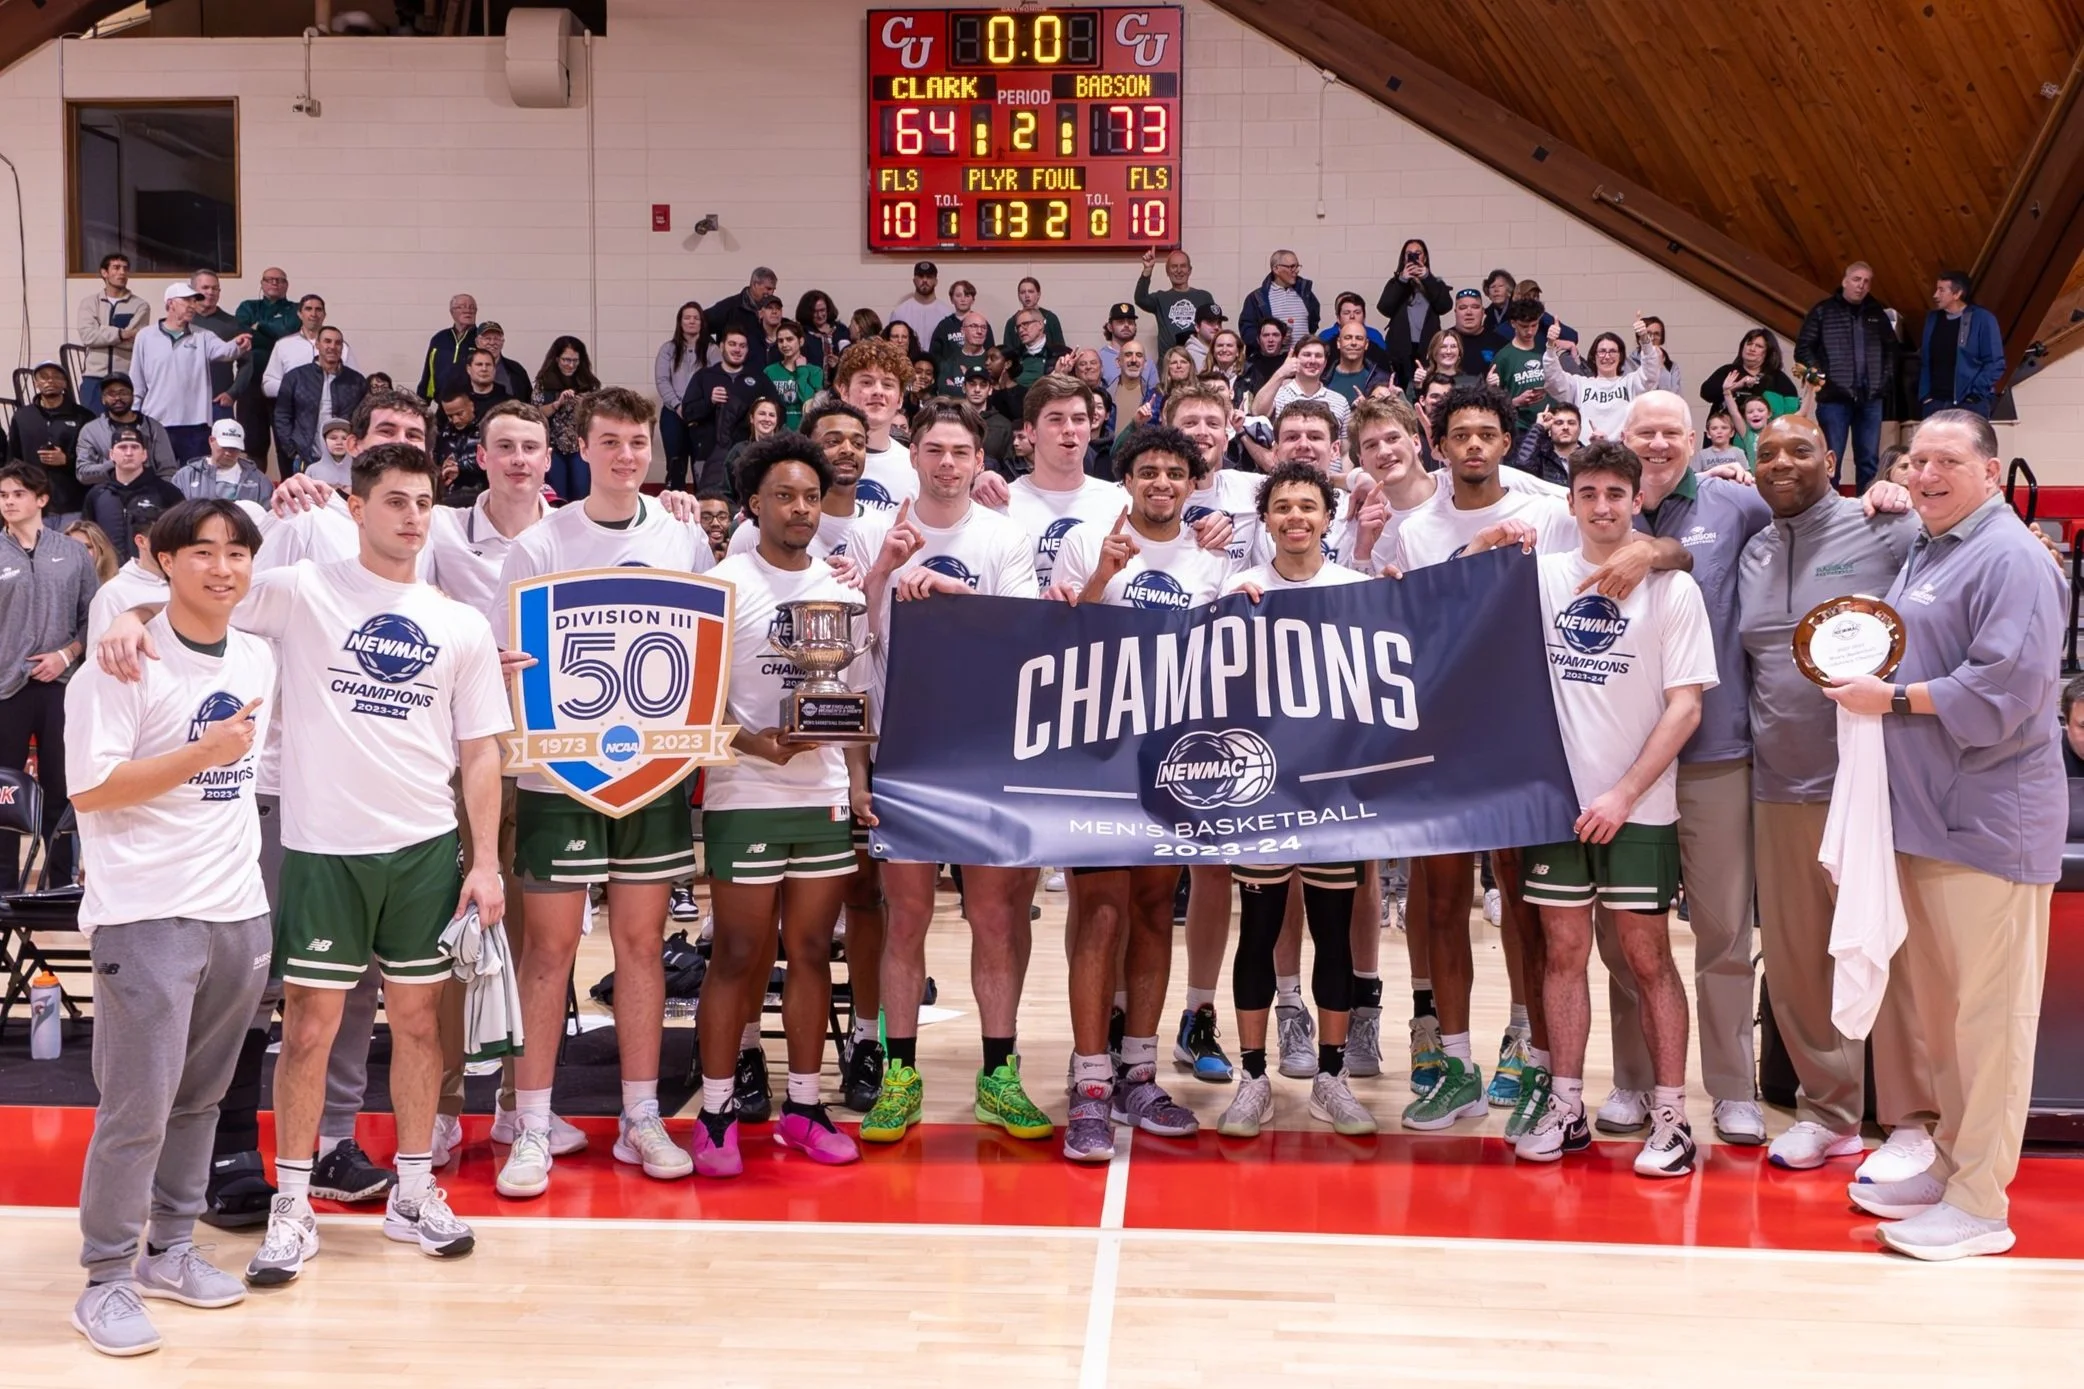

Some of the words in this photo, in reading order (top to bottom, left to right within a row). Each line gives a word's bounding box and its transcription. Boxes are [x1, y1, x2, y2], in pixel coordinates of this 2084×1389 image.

[988, 16, 1061, 63] 0.0
[892, 76, 978, 99] CLARK
[997, 90, 1051, 105] PERIOD
[1076, 75, 1151, 97] BABSON
[896, 108, 955, 155] 64
[1013, 112, 1036, 150] 2
[1109, 106, 1166, 153] 73
[881, 169, 919, 192] FLS
[968, 168, 1018, 191] PLYR
[1032, 168, 1082, 191] FOUL
[1131, 167, 1168, 190] FLS
[934, 194, 964, 207] T.O.L.
[1085, 193, 1114, 206] T.O.L.
[883, 201, 916, 238] 10
[1091, 209, 1108, 236] 0
[1132, 200, 1165, 237] 10
[1582, 386, 1631, 404] BABSON
[1681, 532, 1717, 544] BABSON
[1125, 585, 1190, 608] NEWMAC
[556, 609, 661, 631] DIVISION
[670, 613, 692, 629] III
[1555, 614, 1626, 635] NEWMAC
[346, 633, 436, 663] NEWMAC
[1549, 652, 1630, 674] CHAMPIONS
[558, 631, 690, 720] 50
[331, 679, 435, 708] CHAMPIONS
[1013, 615, 1420, 761] CHAMPIONS
[357, 703, 406, 717] 2023-24
[538, 737, 588, 754] 1973
[605, 742, 640, 754] NCAA
[652, 734, 704, 751] 2023
[1160, 758, 1246, 782] NEWMAC
[1070, 820, 1164, 839] MEN'S
[1175, 803, 1378, 839] BASKETBALL
[1154, 835, 1301, 856] 2023-24
